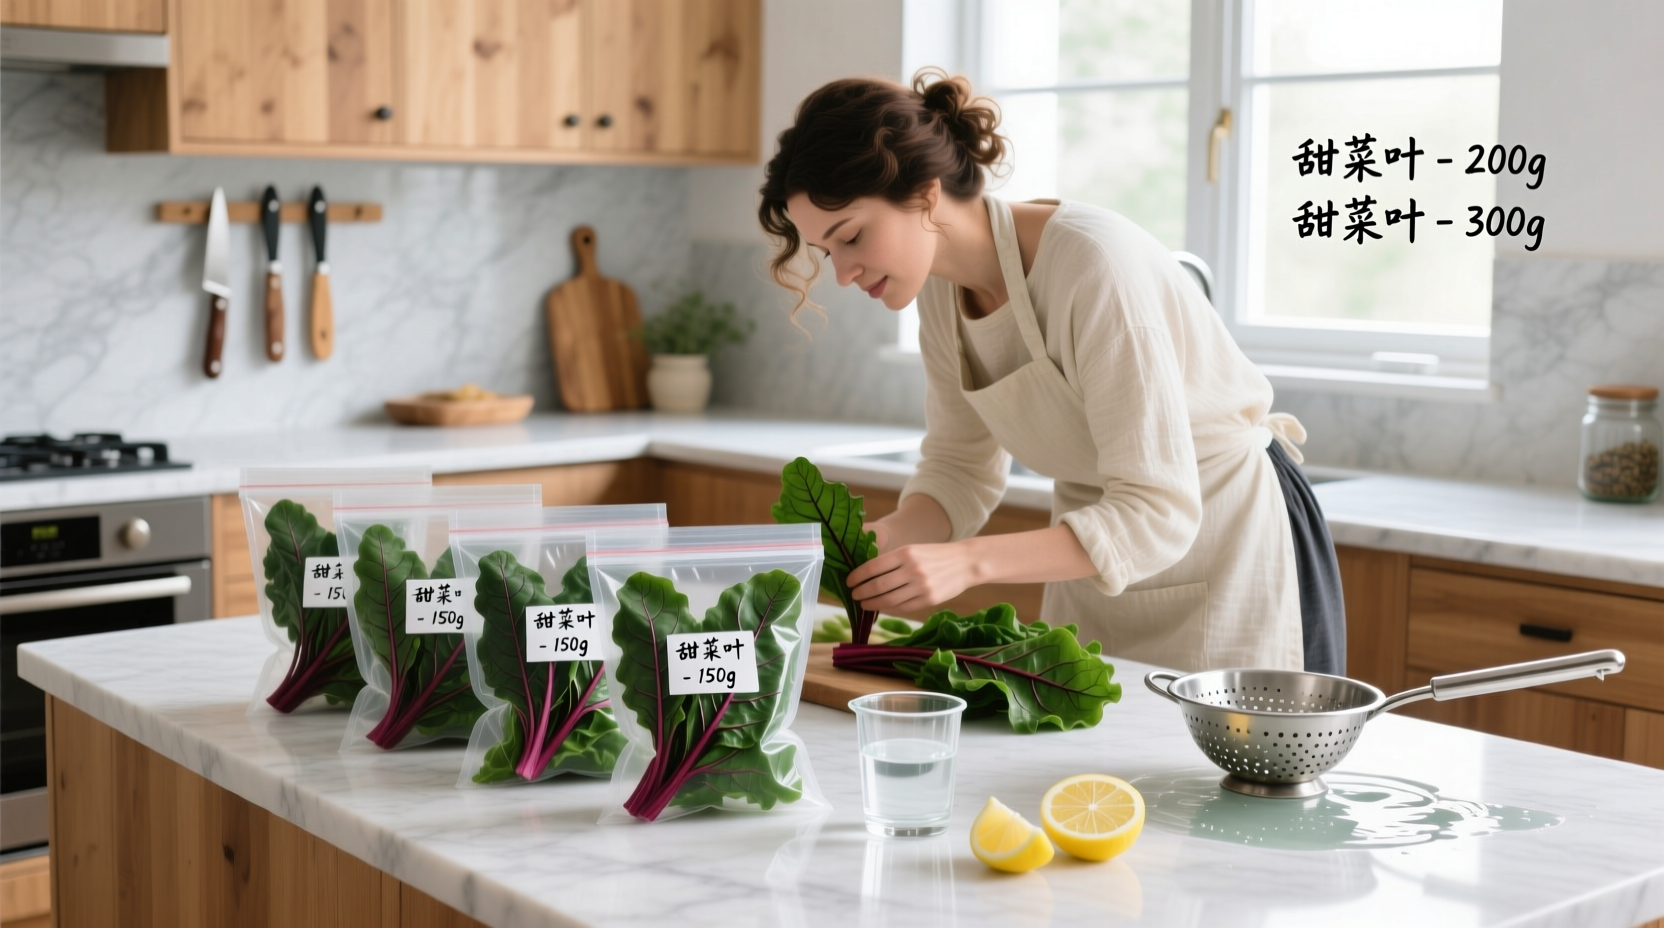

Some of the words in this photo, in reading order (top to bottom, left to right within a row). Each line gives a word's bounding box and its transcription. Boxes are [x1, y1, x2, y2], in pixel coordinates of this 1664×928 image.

[327, 586, 346, 600] 15
[432, 610, 464, 630] 150g
[533, 607, 596, 631] 甜菜叶
[554, 637, 588, 657] 150g
[675, 636, 745, 662] 甜菜叶
[698, 667, 736, 689] 150g
